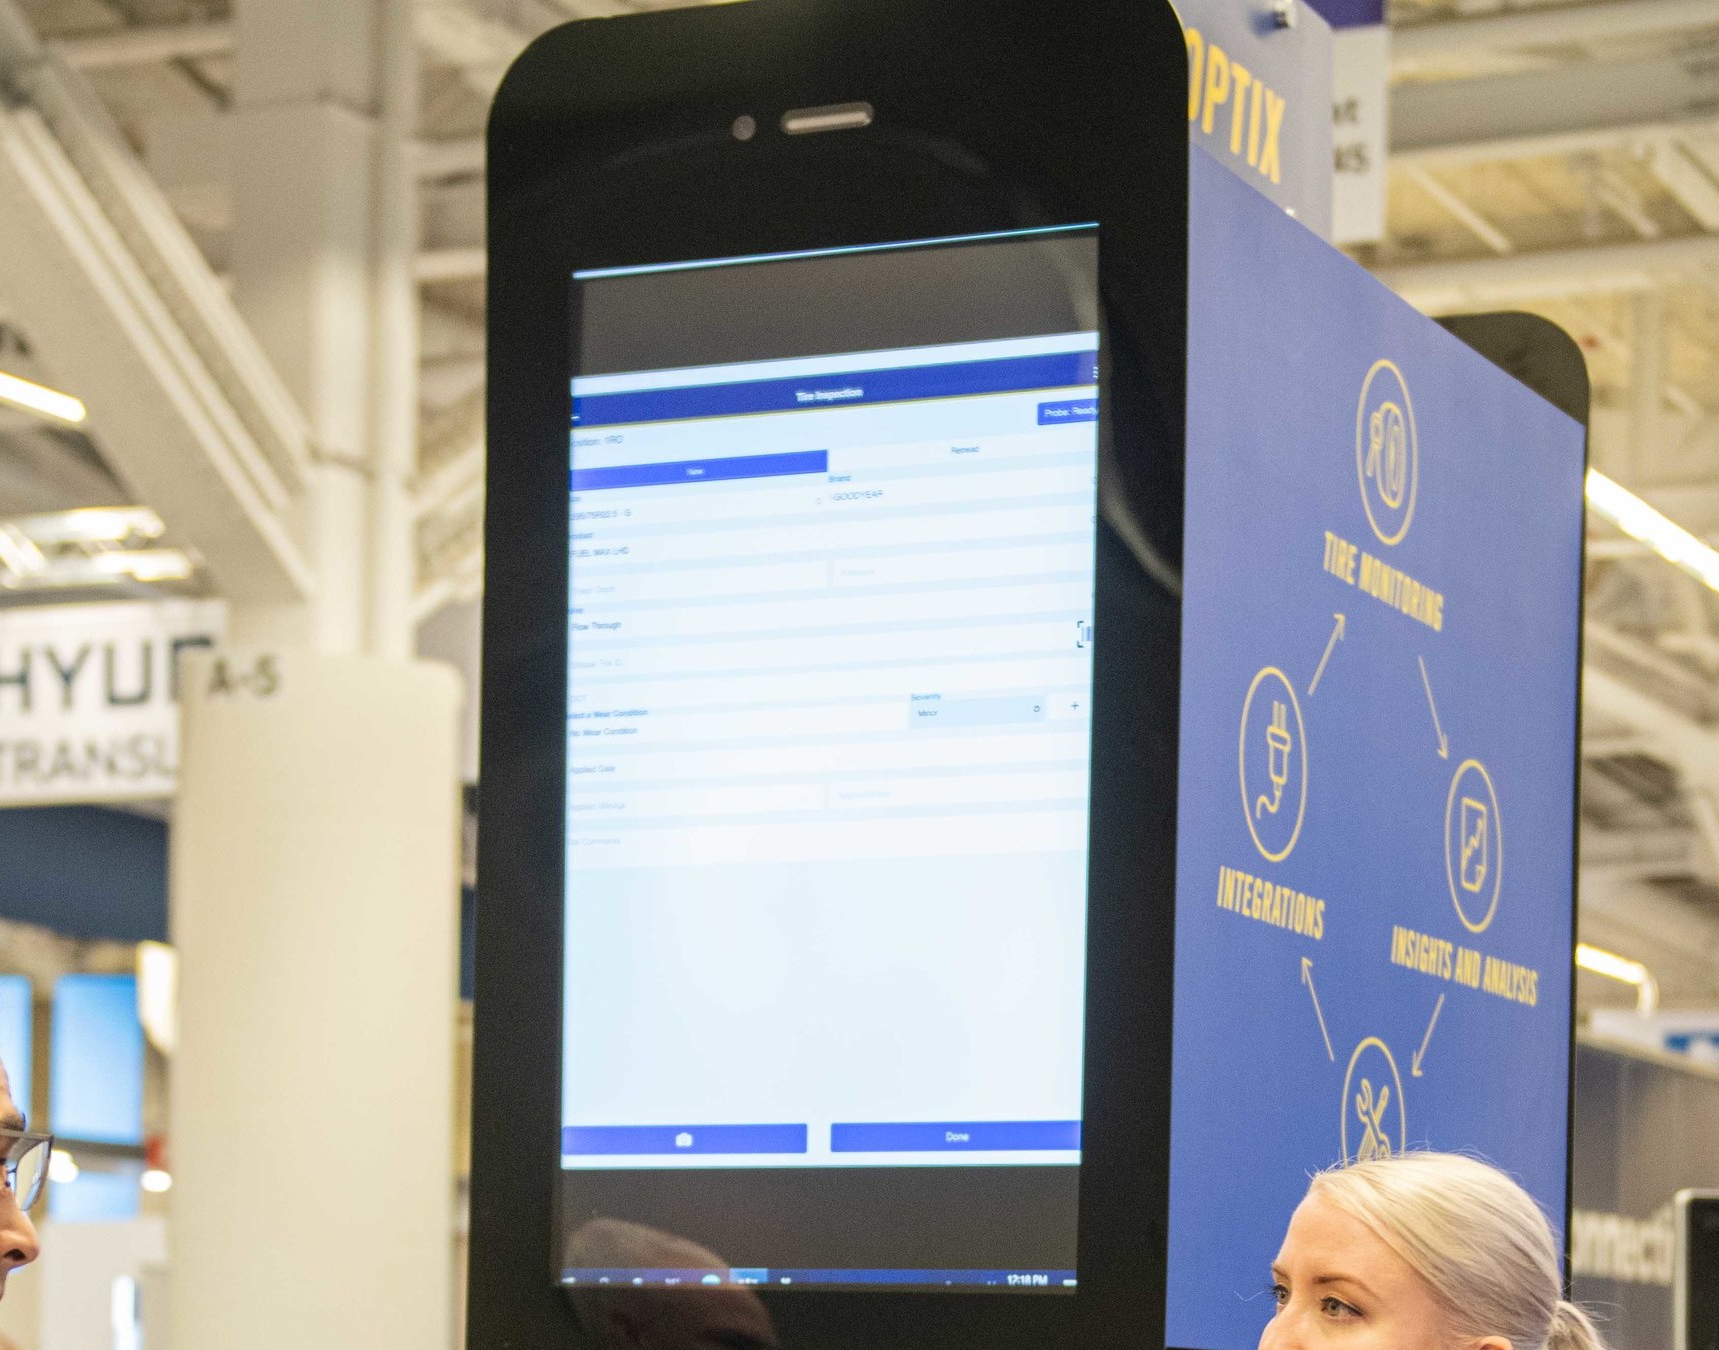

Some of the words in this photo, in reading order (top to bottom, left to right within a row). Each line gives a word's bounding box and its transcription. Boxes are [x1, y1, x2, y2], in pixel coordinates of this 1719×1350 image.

[1323, 530, 1358, 585] TIRE
[1358, 551, 1445, 632] MONITORING
[1216, 865, 1326, 941] INTEGRATIONS
[1390, 925, 1454, 983] INSIGHTS
[1454, 946, 1483, 990] AND
[1482, 956, 1539, 1007] ANALYSIS
[945, 1131, 970, 1142] Done
[1032, 1274, 1048, 1286] PM
